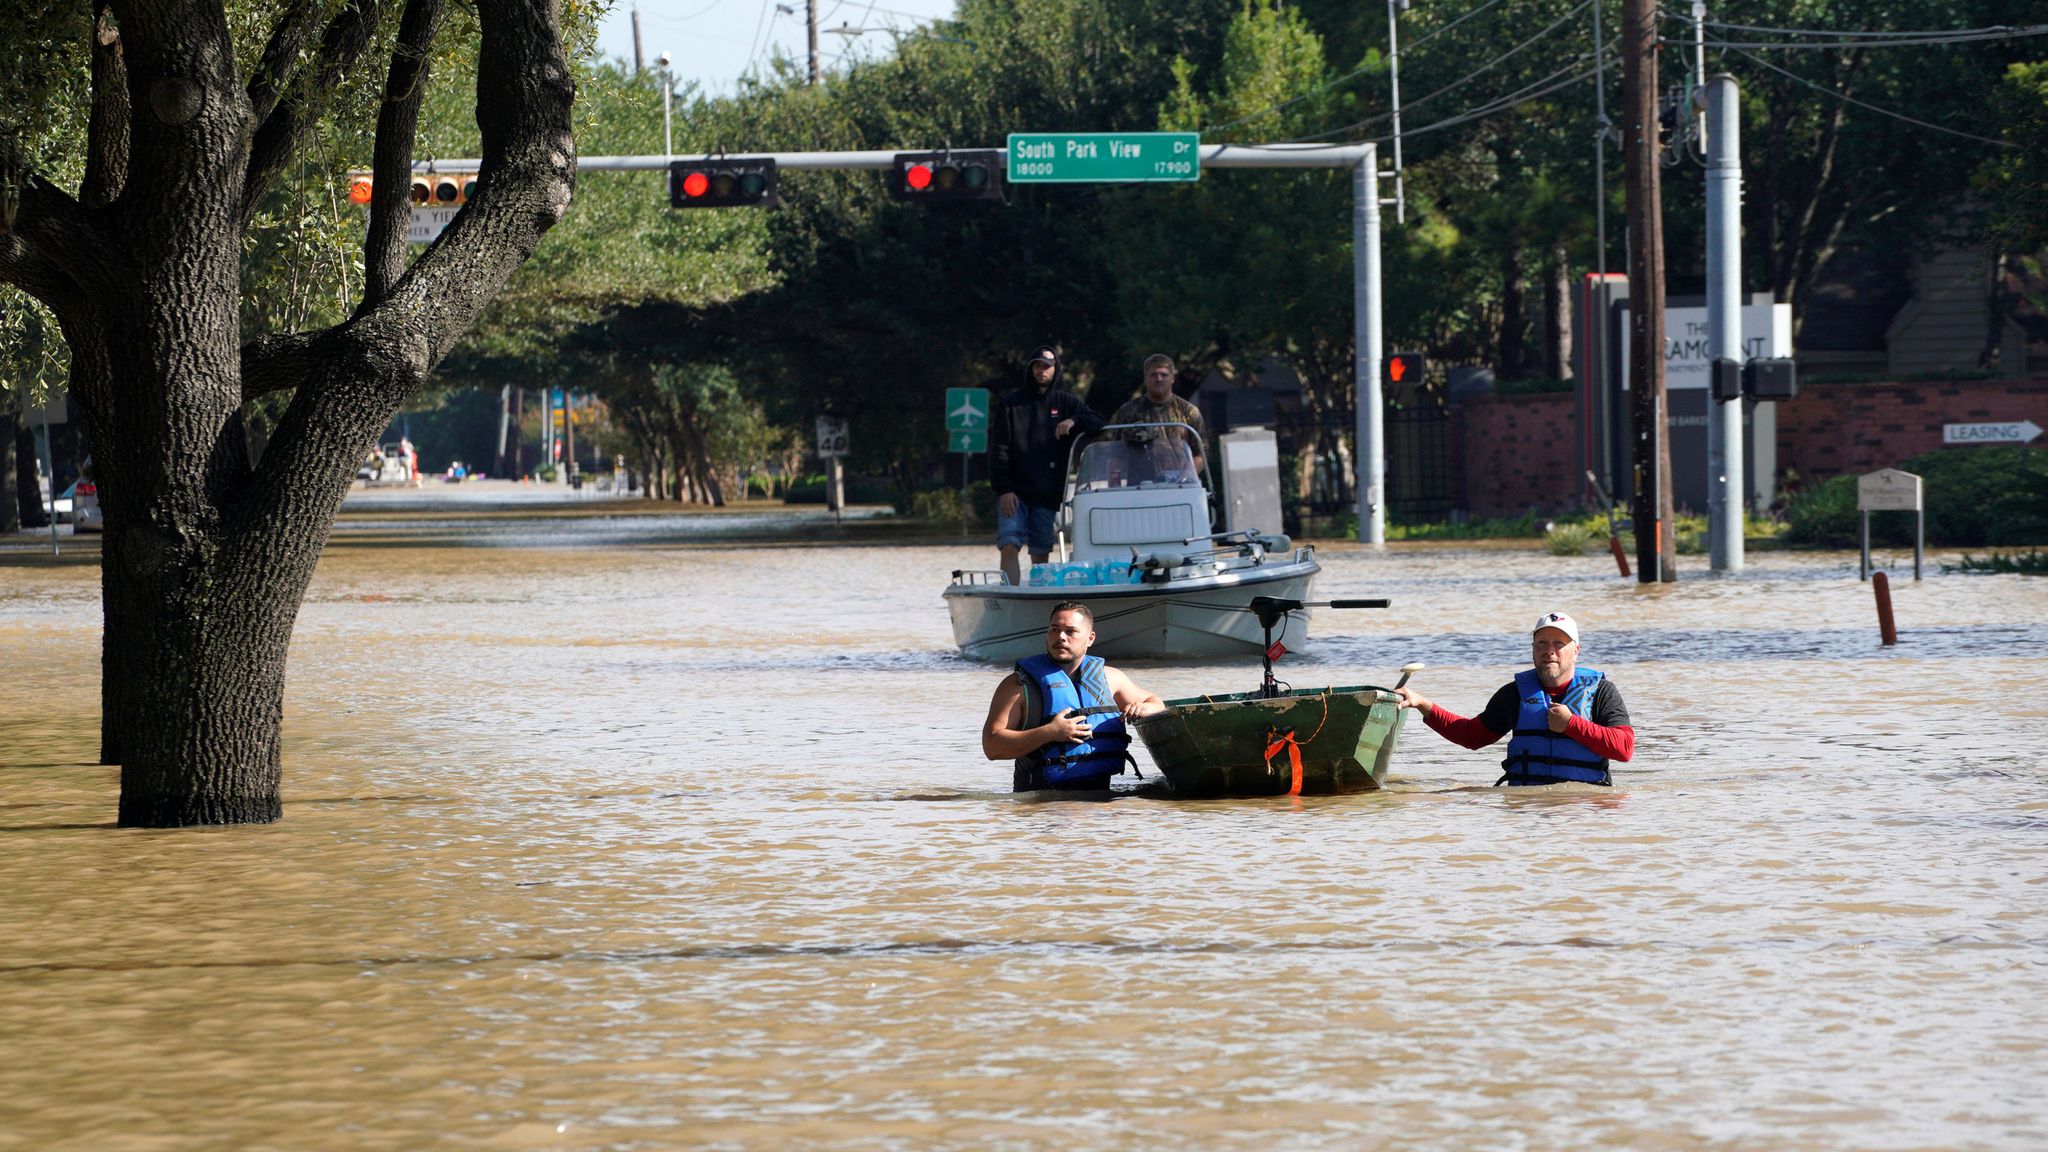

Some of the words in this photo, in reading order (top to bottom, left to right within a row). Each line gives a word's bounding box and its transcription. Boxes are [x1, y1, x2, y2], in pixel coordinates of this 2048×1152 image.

[1016, 140, 1055, 159] South
[1066, 140, 1098, 158] Park
[1109, 140, 1142, 158] View
[1173, 141, 1191, 154] Dr
[1016, 163, 1053, 175] 18000
[1154, 162, 1191, 174] 17900
[1685, 322, 1709, 336] THE
[1951, 425, 2020, 440] LEASING
